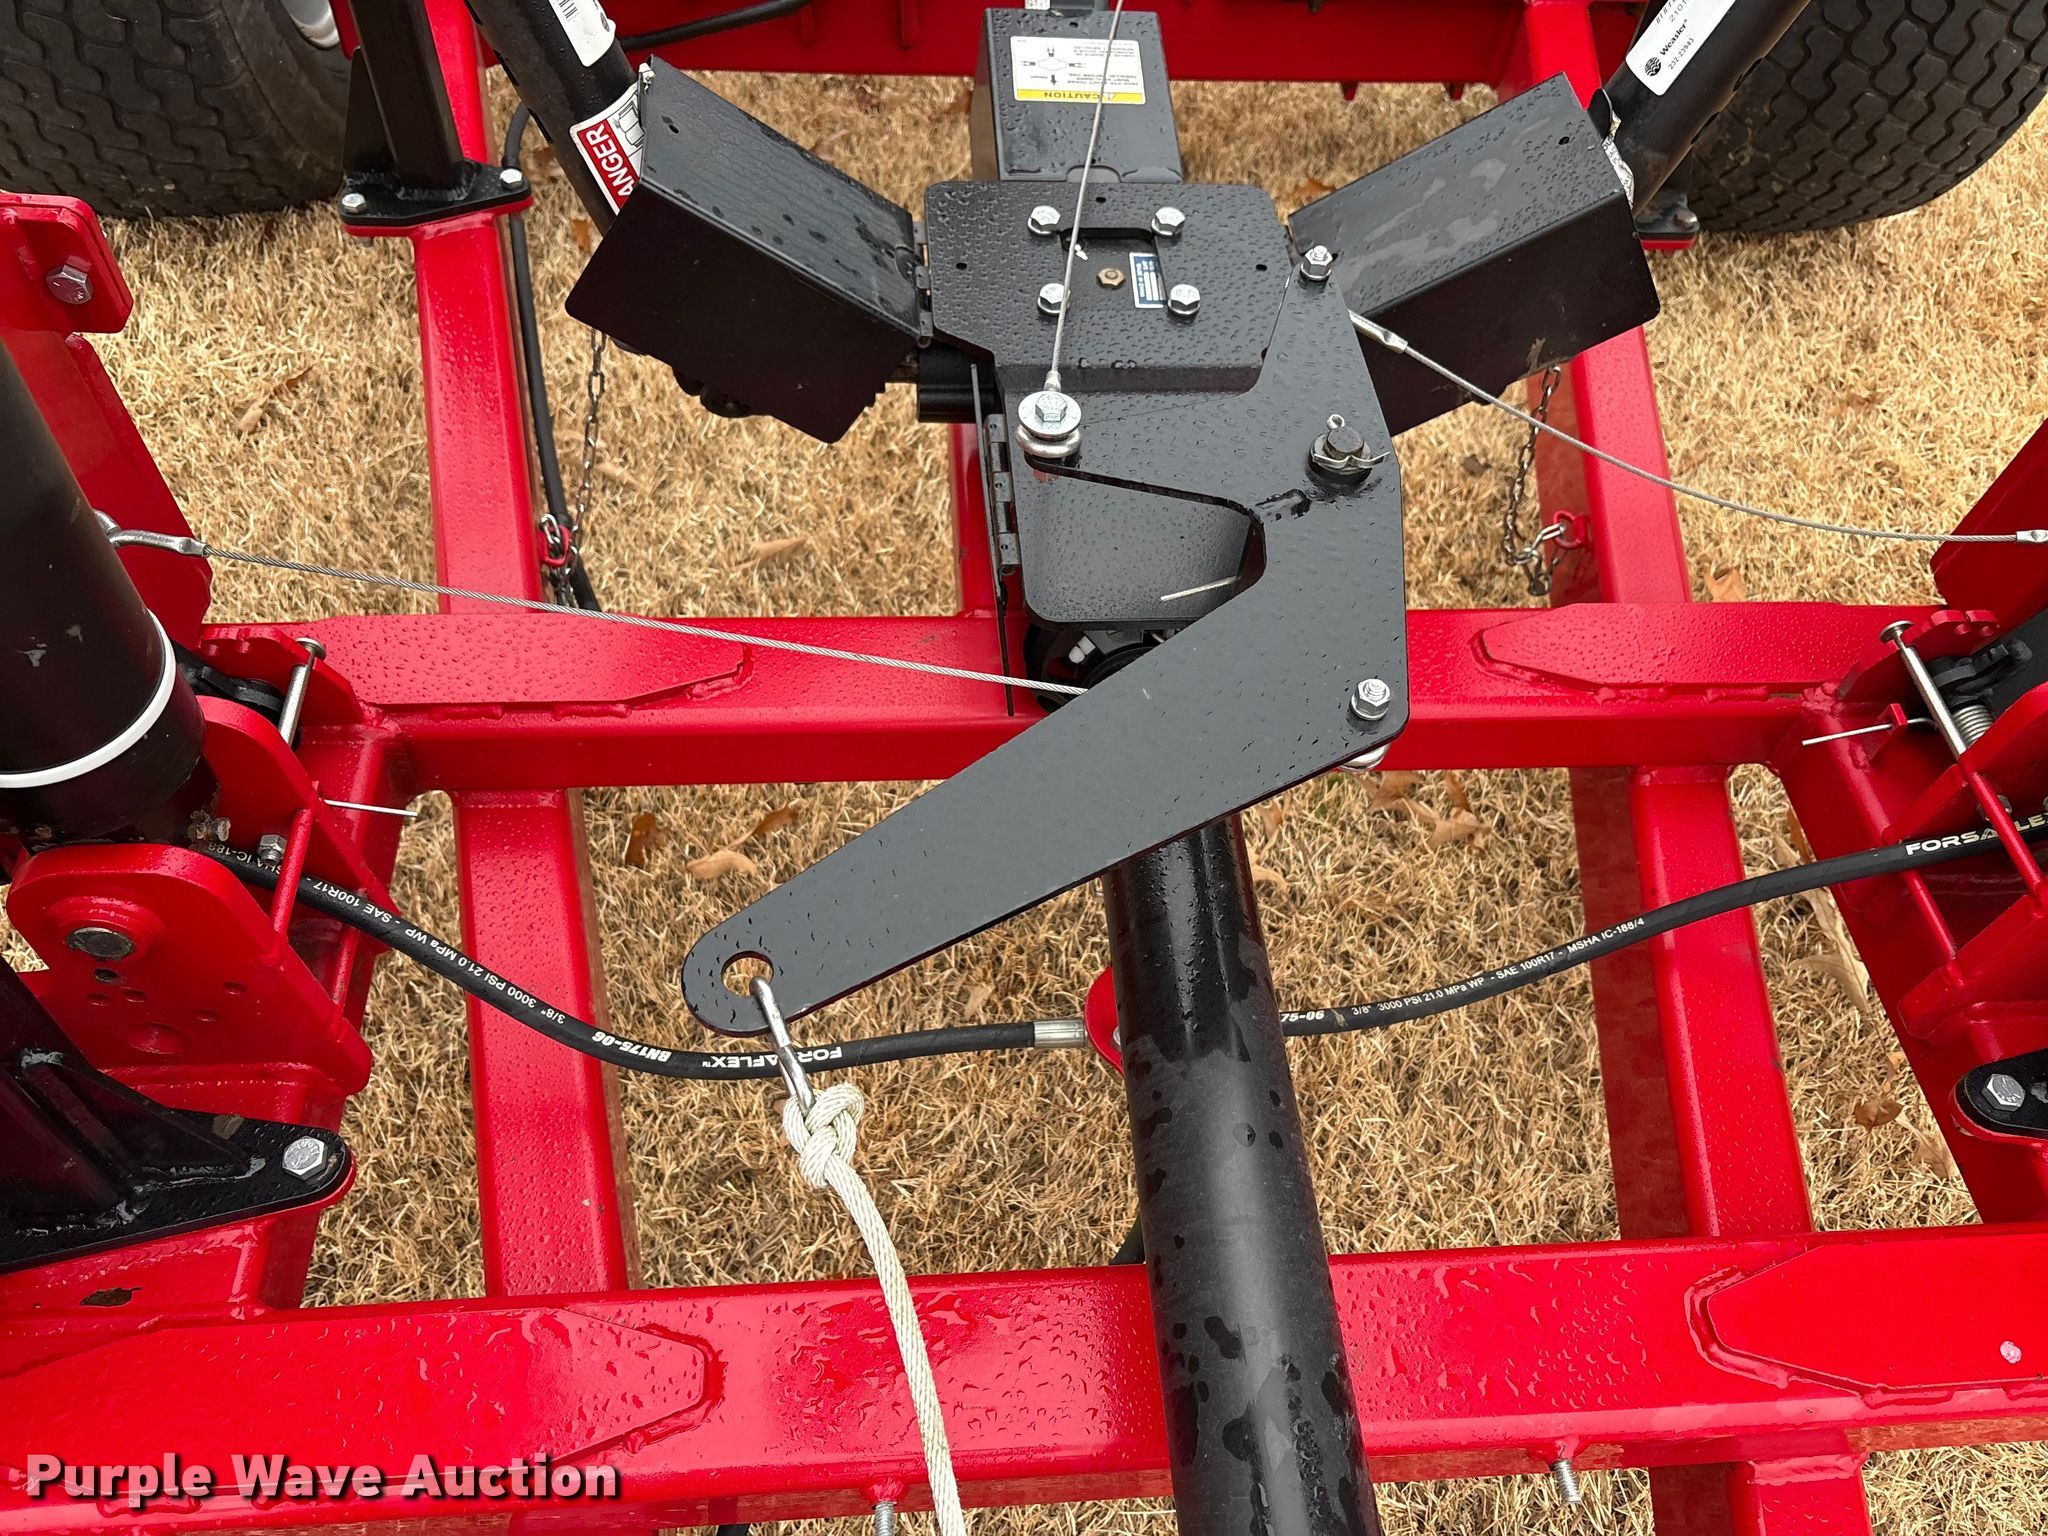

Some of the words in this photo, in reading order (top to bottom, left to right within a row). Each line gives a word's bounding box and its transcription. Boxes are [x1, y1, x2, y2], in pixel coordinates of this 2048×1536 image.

[1044, 91, 1100, 100] CAUTION
[586, 123, 635, 197] ANGER
[1905, 812, 2048, 856] FORSALE
[313, 881, 361, 907] 100R17
[363, 903, 393, 923] SAE
[405, 928, 428, 945] WP
[430, 941, 458, 961] MPa
[458, 957, 484, 977] 21.0
[1280, 1010, 1325, 1022] 75-06
[1377, 1000, 1403, 1012] 3000
[1404, 996, 1422, 1007] PSI
[1424, 990, 1444, 1002] 21.0
[1446, 984, 1468, 996] MPa
[1469, 977, 1485, 989] WP
[1496, 966, 1519, 980] SAE
[1520, 952, 1555, 972] 100R17
[1566, 935, 1601, 954] MSHA
[1600, 917, 1645, 941] IC-188/4
[484, 974, 507, 991] PSI
[507, 986, 537, 1008] 3000
[541, 1008, 566, 1024] 3/8"
[592, 1030, 672, 1063] BN175-06
